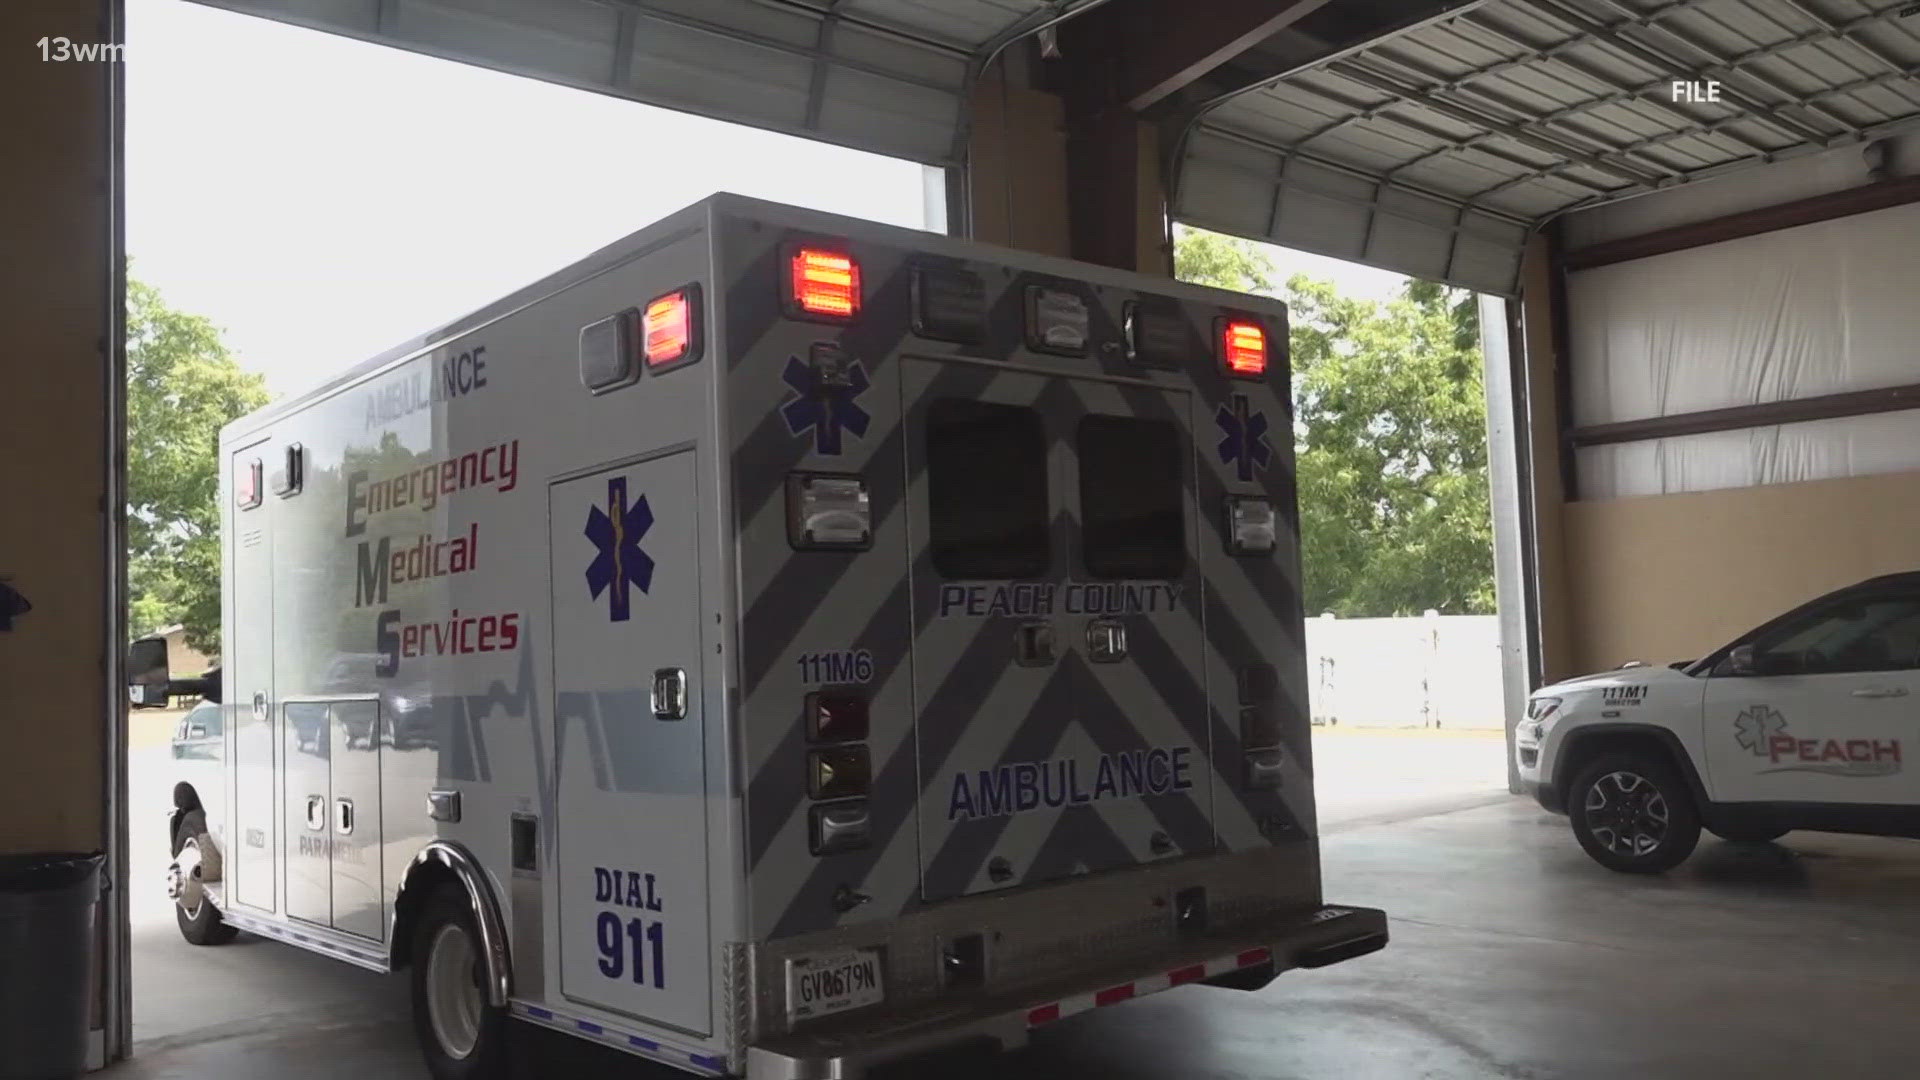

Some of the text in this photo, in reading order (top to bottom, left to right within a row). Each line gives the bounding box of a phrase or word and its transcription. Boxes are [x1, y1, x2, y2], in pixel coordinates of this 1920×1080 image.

[346, 440, 518, 537] Emergency
[355, 523, 477, 608] Medical
[940, 583, 1183, 617] PEACH COUNTY
[376, 609, 518, 678] Services
[797, 649, 873, 684] 111M6
[1601, 684, 1649, 699] 111M1
[1768, 735, 1902, 764] PEACH
[948, 747, 1192, 820] AMBULANCE
[594, 867, 662, 912] DIAL
[597, 910, 665, 990] 911
[800, 959, 876, 1003] GV8679N
